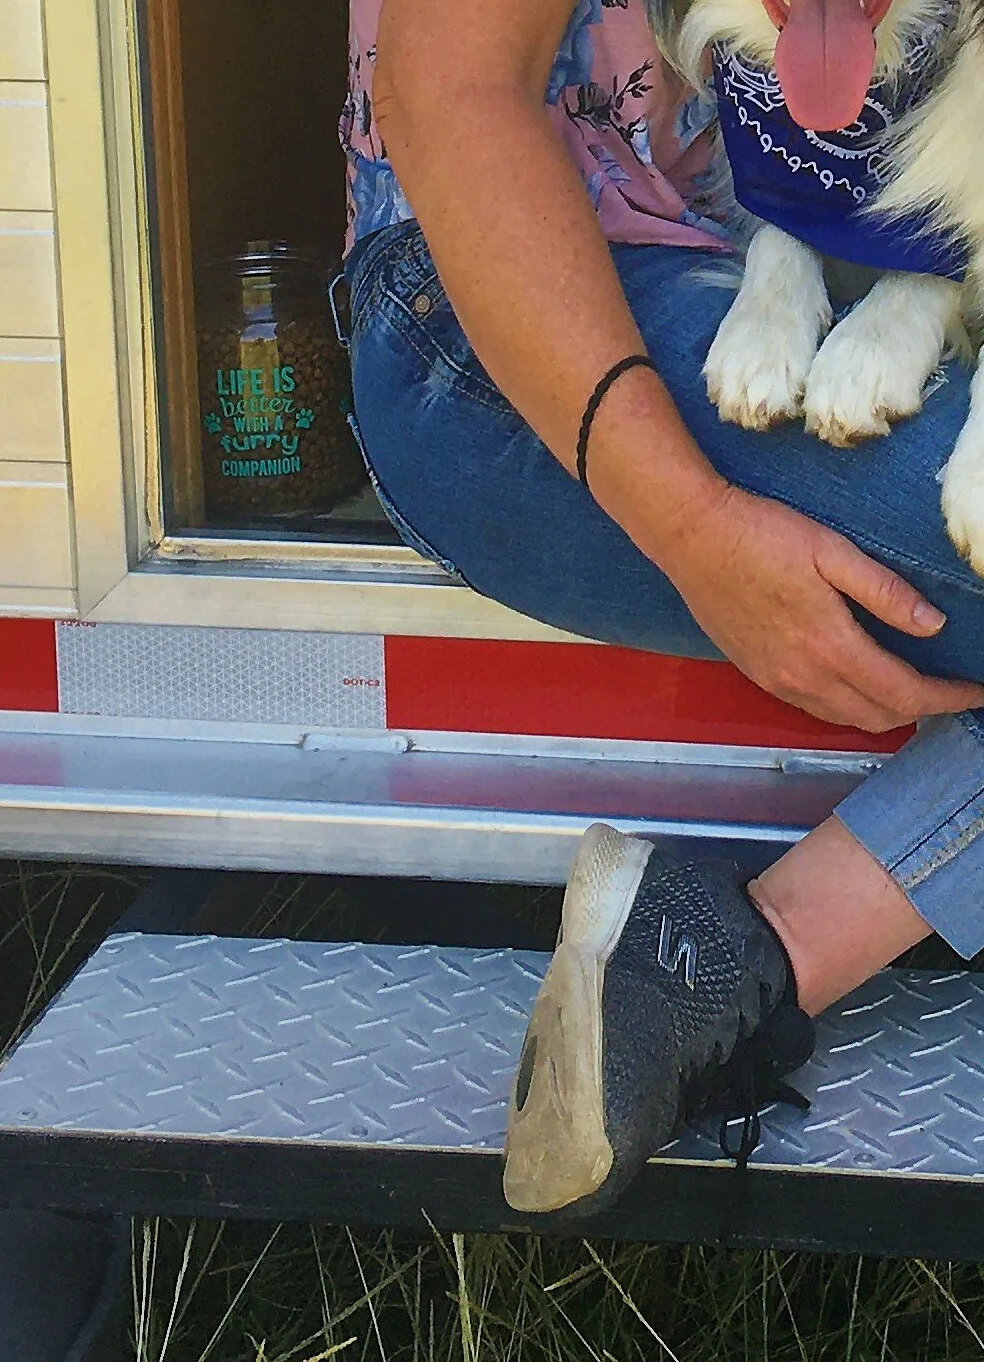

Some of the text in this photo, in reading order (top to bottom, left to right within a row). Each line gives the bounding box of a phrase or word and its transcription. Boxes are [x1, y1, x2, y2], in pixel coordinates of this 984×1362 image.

[216, 366, 296, 395] LIFE IS
[219, 396, 295, 418] better
[234, 415, 284, 433] WITH A
[221, 433, 299, 455] furry
[222, 456, 301, 477] COMPANION
